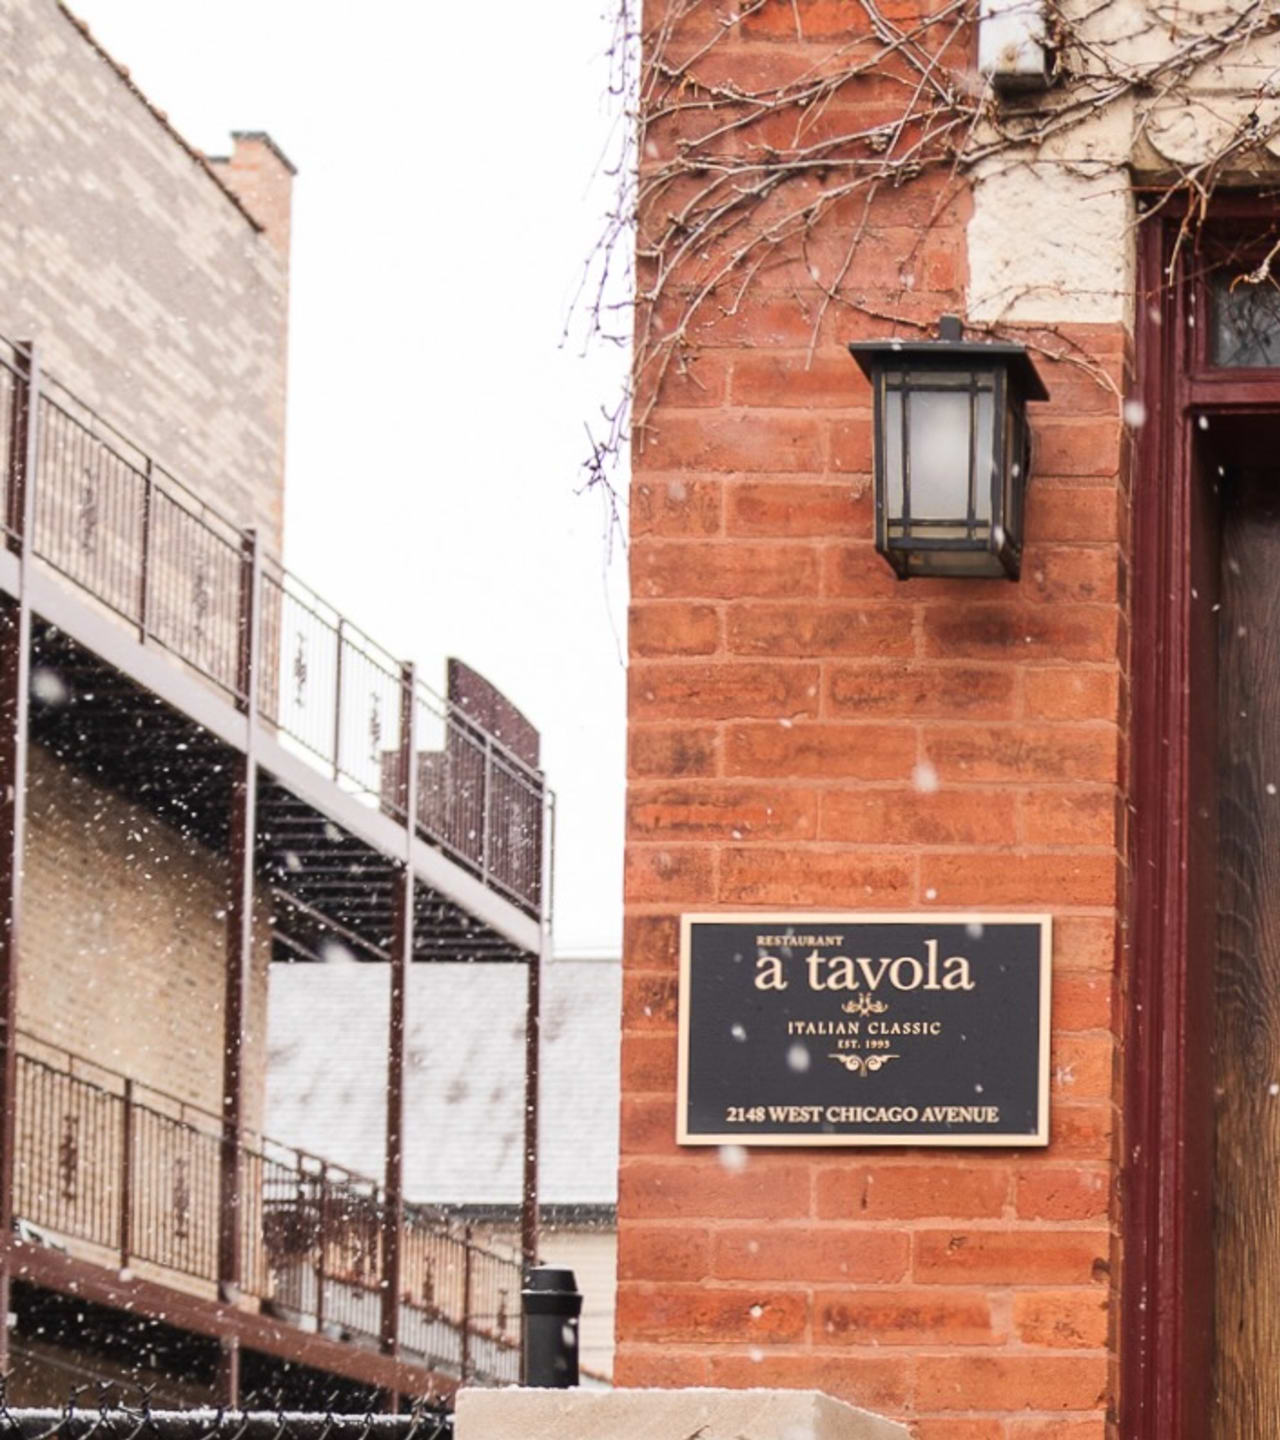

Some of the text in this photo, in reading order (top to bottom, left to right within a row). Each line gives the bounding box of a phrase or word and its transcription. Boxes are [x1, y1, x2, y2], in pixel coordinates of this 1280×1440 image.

[756, 934, 844, 947] RESTAURANT
[754, 938, 976, 991] a tavola
[788, 1021, 942, 1036] ITALIAN CLASSIC
[837, 1039, 861, 1050] EST.
[726, 1106, 1000, 1124] 2148 WEST CHICAGO AVENUE
